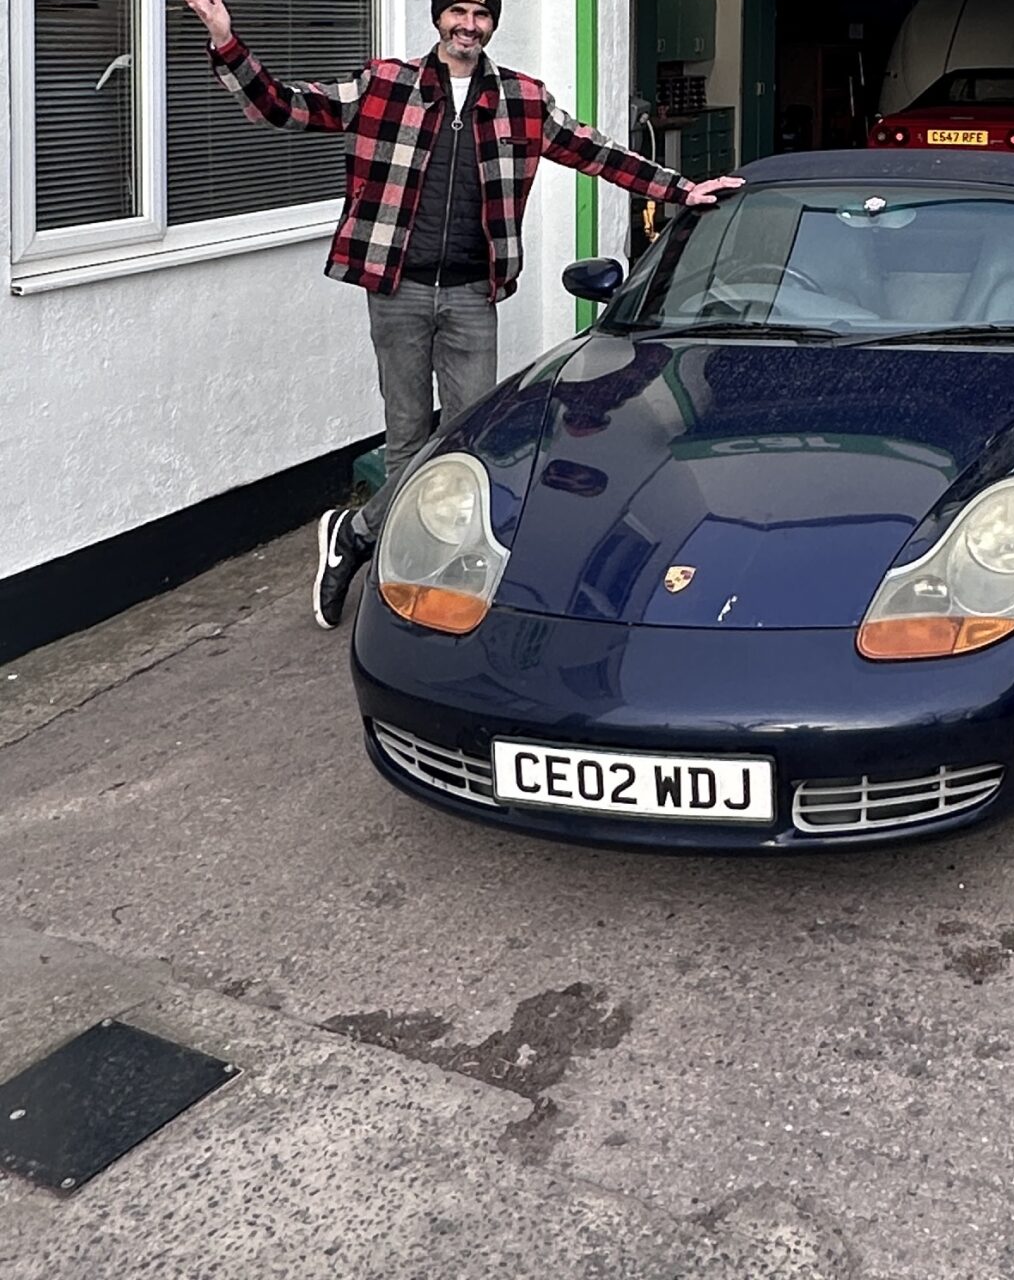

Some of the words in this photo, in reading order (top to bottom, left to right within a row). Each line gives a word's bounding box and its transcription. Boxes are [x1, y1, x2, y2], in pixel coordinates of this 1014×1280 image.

[931, 131, 960, 142] C547
[962, 132, 984, 143] RFE
[514, 750, 638, 806] CE02
[654, 765, 752, 810] WDJ
